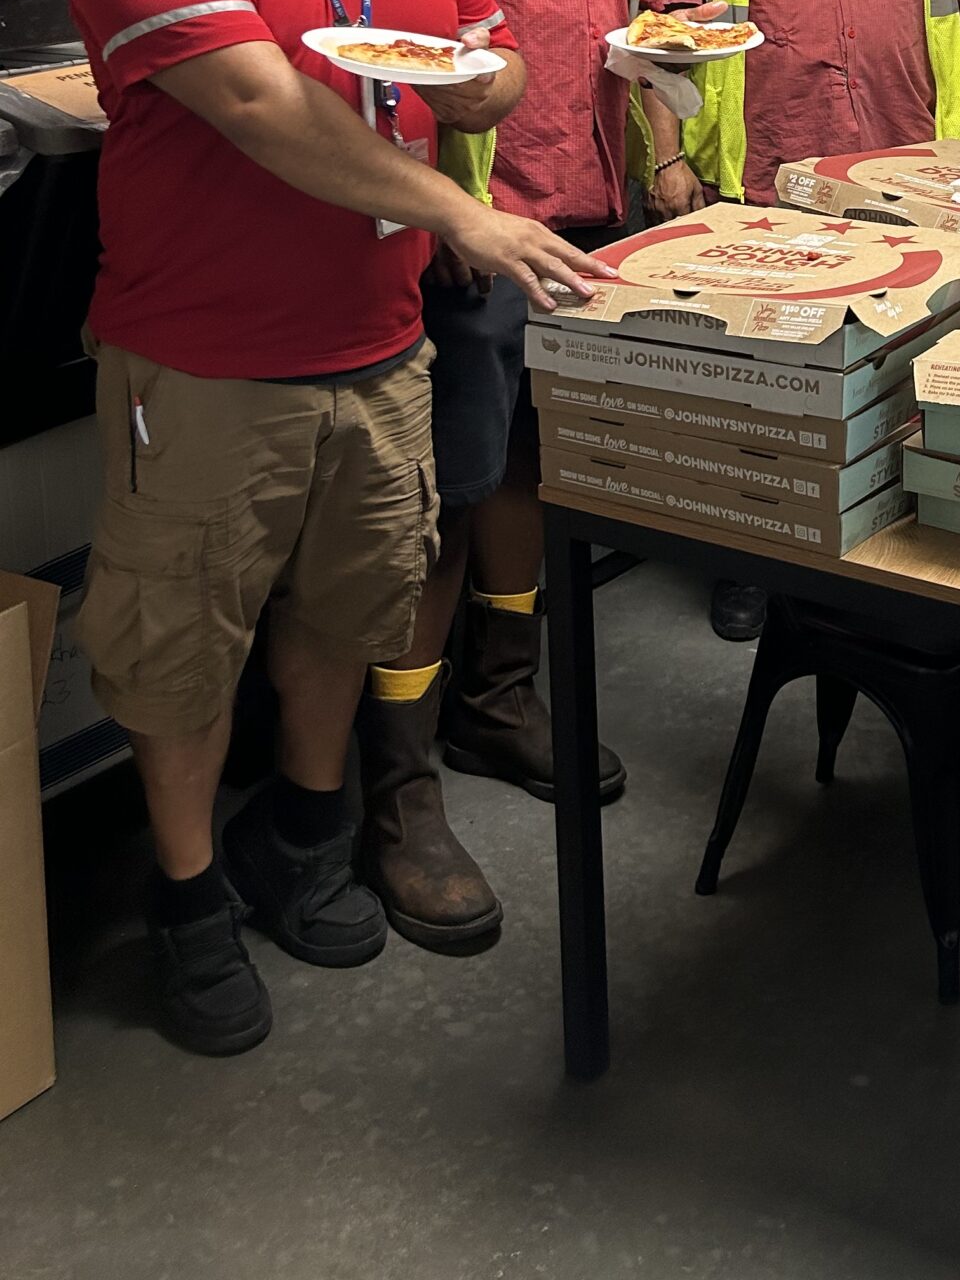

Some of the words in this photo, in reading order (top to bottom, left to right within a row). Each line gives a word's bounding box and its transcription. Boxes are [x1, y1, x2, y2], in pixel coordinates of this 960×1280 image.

[799, 177, 816, 187] OFF
[696, 249, 845, 270] DOUGH
[800, 306, 827, 318] OFF
[565, 349, 590, 360] ORDER
[592, 352, 621, 365] DIRECT!
[566, 339, 584, 350] SAVE
[586, 342, 613, 355] DOUGH
[615, 348, 620, 356] &
[623, 350, 820, 395] JOHNNYSPIZZA.COM
[931, 363, 960, 372] REHEATING
[600, 392, 625, 408] love
[627, 401, 636, 409] ON
[664, 407, 796, 442] @JOHNNYSNYPIZZA
[603, 433, 628, 450] love
[664, 451, 790, 490] @JOHNNYSNYPIZZA
[869, 460, 900, 488] STYL
[605, 476, 629, 493] love
[665, 494, 792, 535] @JOHNNYSNYPIZZA
